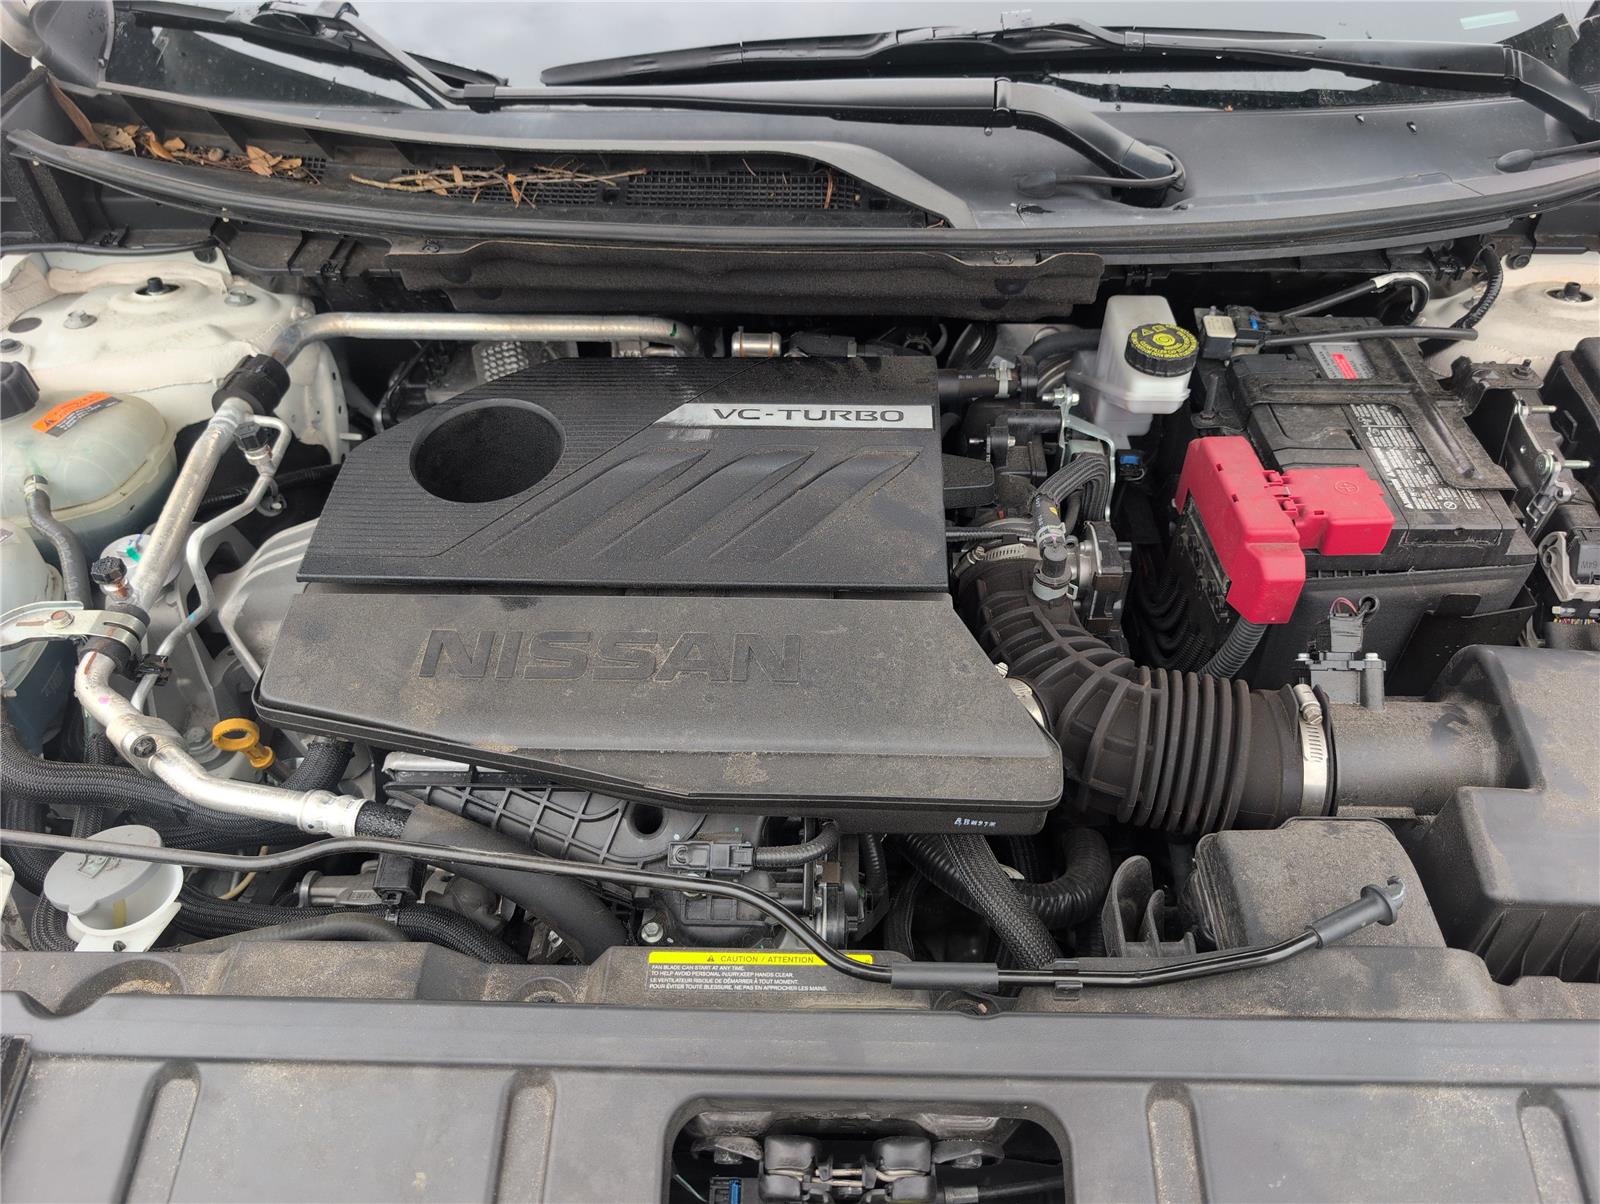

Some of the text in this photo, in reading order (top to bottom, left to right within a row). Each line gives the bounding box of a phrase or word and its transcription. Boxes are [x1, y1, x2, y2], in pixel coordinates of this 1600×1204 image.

[714, 407, 905, 423] VC-TURBO
[418, 629, 802, 684] NISSAN
[720, 955, 758, 963] CAUTION
[767, 956, 814, 964] ATTENTION
